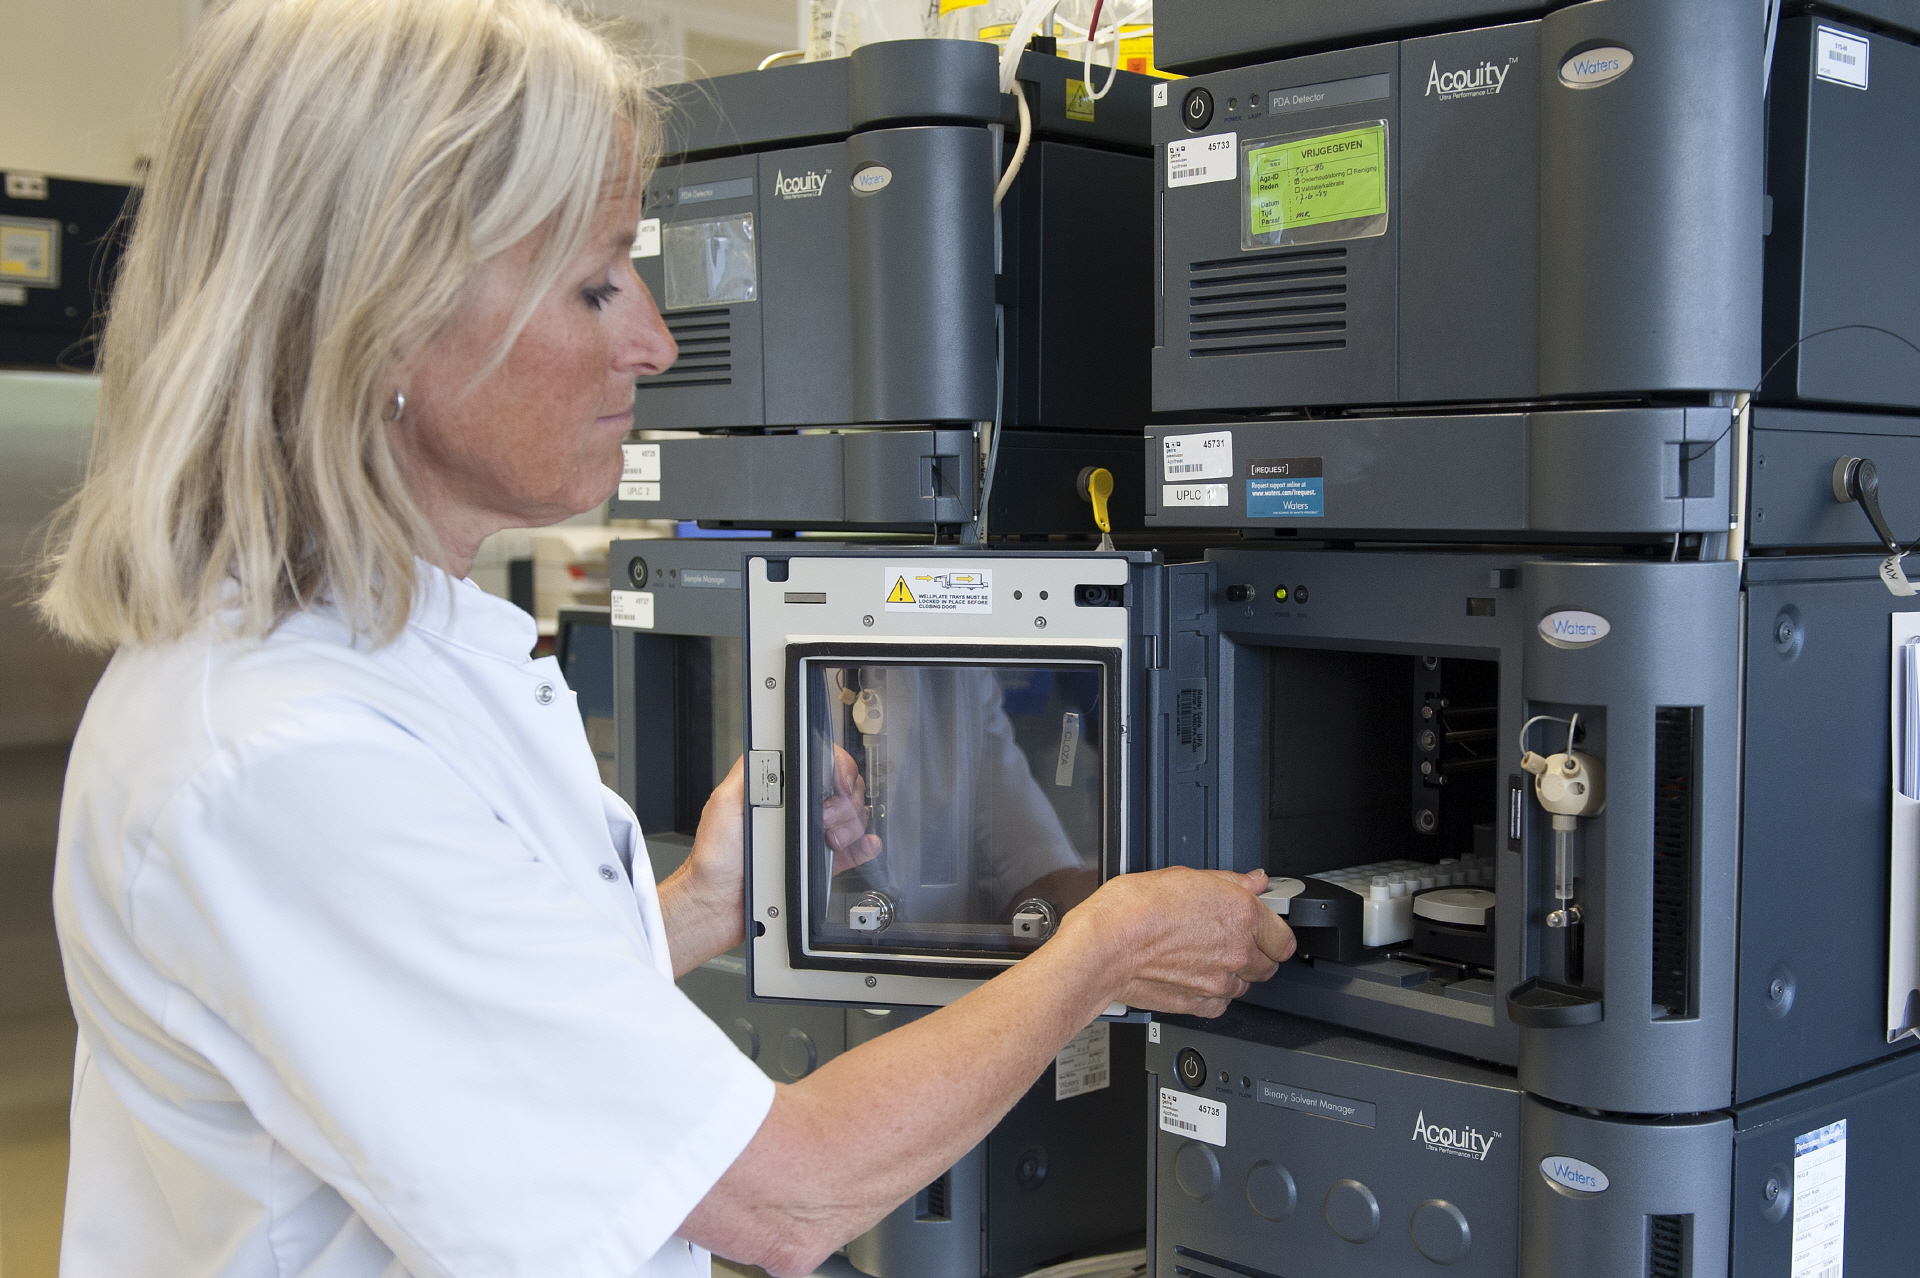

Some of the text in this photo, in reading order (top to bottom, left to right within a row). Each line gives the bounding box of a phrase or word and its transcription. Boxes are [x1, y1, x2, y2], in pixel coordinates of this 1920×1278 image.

[1573, 58, 1619, 77] Waters
[1425, 60, 1510, 96] Acquity
[1157, 90, 1163, 100] 4
[1453, 90, 1485, 99] Performance
[1273, 93, 1325, 107] PDA Detector
[1208, 141, 1230, 151] 45733
[1301, 140, 1363, 159] VRIJGEGEVEN
[1353, 165, 1378, 175] Reiniging
[774, 168, 827, 197] Acquity
[859, 175, 885, 186] Waters
[1260, 183, 1279, 191] Reden
[1260, 200, 1279, 209] Datum
[1261, 210, 1272, 219] Tijd
[1203, 439, 1225, 448] 45731
[1251, 482, 1269, 490] Request
[646, 487, 650, 496] 2
[1176, 490, 1202, 500] UPLC
[1283, 501, 1309, 510] Waters
[703, 576, 725, 585] Manager
[1552, 620, 1597, 636] Waters
[1061, 731, 1073, 766] CLOZA
[1152, 1027, 1158, 1038] 3
[1215, 1086, 1233, 1095] POWER
[1264, 1087, 1356, 1115] Binary Solvent Manager
[1198, 1104, 1220, 1116] 45735
[1411, 1109, 1495, 1161] Acquity
[1438, 1146, 1471, 1158] Performance
[1553, 1161, 1597, 1187] Waters
